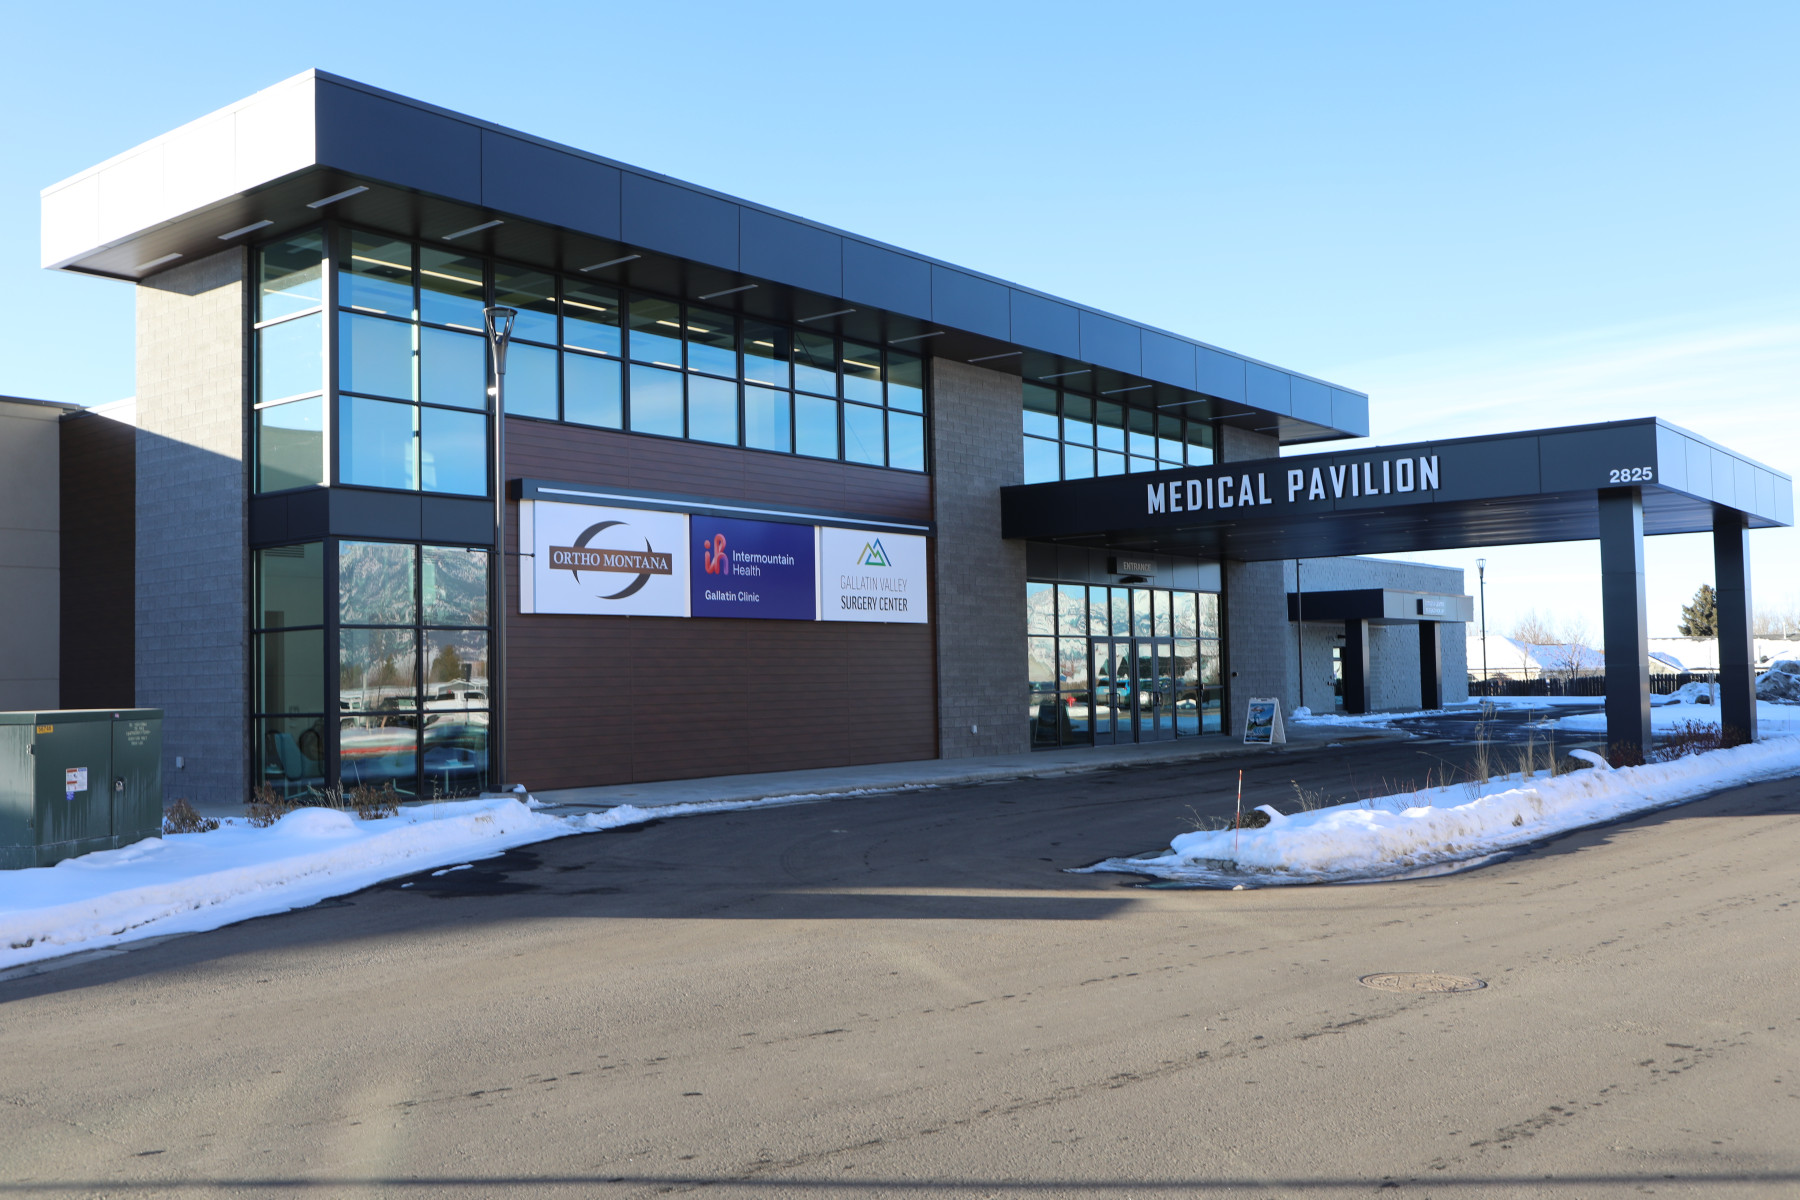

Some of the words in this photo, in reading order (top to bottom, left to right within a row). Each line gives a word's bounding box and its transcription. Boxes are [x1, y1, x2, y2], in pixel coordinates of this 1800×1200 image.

[1609, 466, 1653, 484] 2825
[1147, 472, 1273, 515] MEDICAL
[1287, 455, 1440, 503] PAVILION
[553, 550, 601, 566] ORTHO
[603, 553, 669, 570] MONTANA
[732, 549, 795, 566] Intermountain
[1123, 561, 1152, 572] ENTRANCE
[732, 563, 761, 577] Health
[840, 574, 878, 591] GALLATIN
[879, 577, 908, 593] VALLEY
[705, 589, 736, 602] Gallatin
[738, 591, 760, 602] Clinic
[840, 594, 878, 611] SURGERY
[879, 596, 908, 612] CENTER
